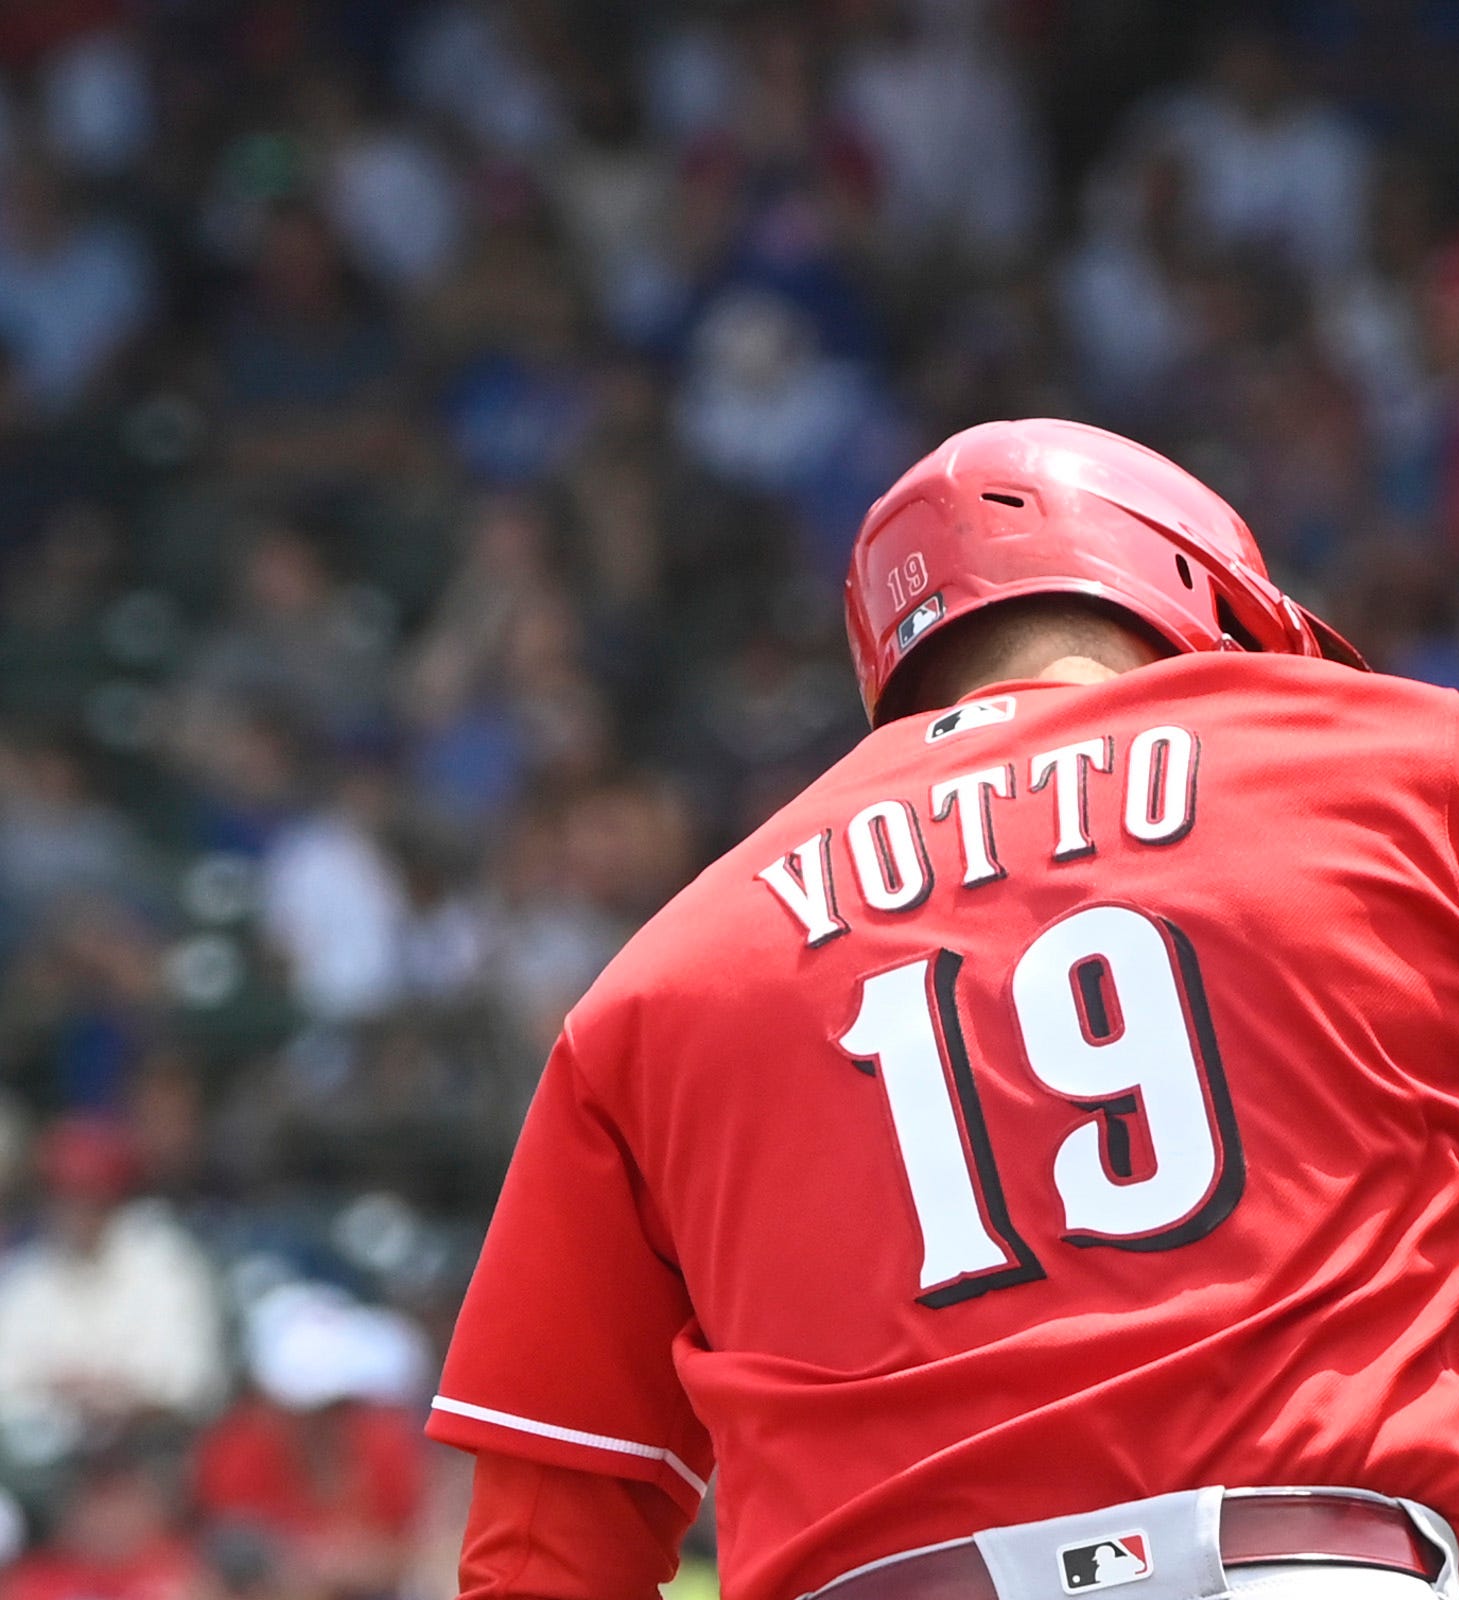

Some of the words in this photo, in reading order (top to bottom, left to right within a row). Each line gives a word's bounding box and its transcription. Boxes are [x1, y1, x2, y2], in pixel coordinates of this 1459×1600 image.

[886, 551, 928, 613] 19
[757, 725, 1201, 948] VOTTO
[827, 898, 1246, 1310] 19
